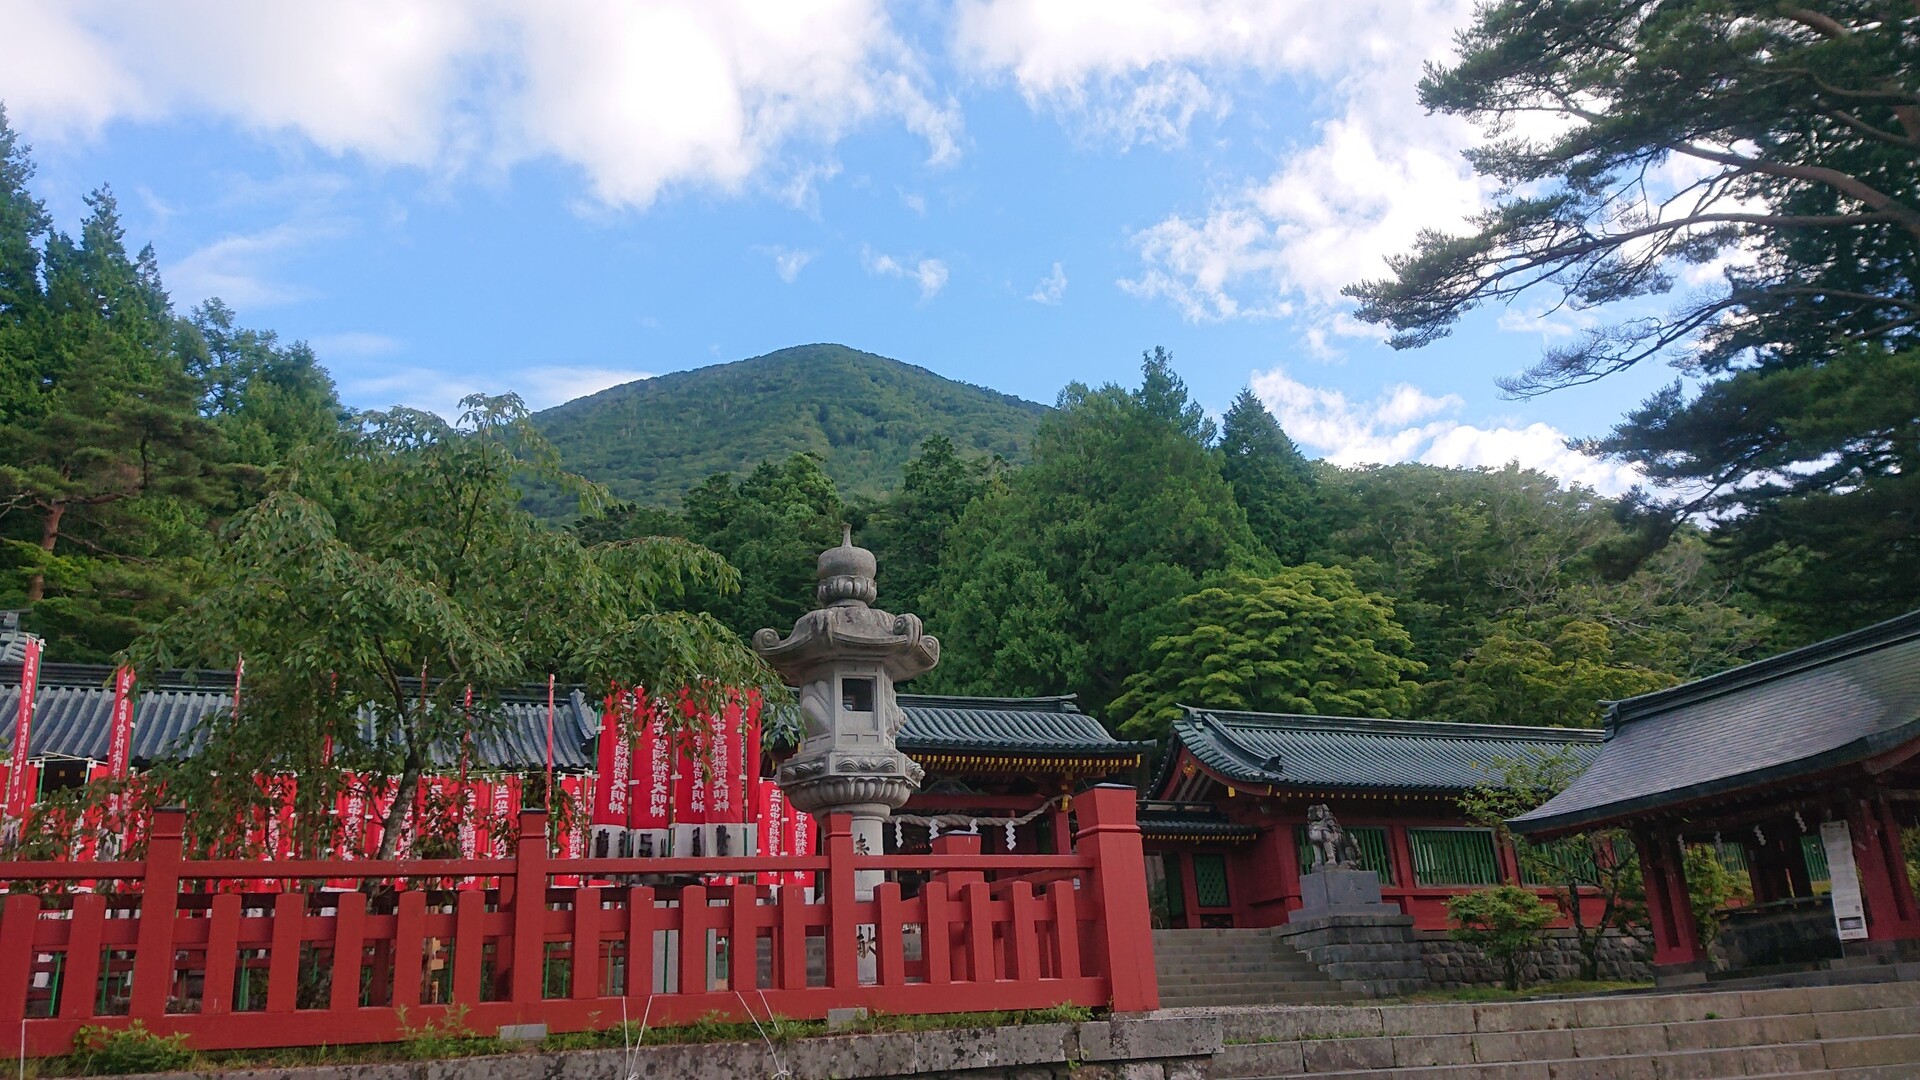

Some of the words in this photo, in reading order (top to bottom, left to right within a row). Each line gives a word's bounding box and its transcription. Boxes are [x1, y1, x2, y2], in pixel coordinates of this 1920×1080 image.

[711, 700, 730, 813] 位中宮祠稲荷大明神
